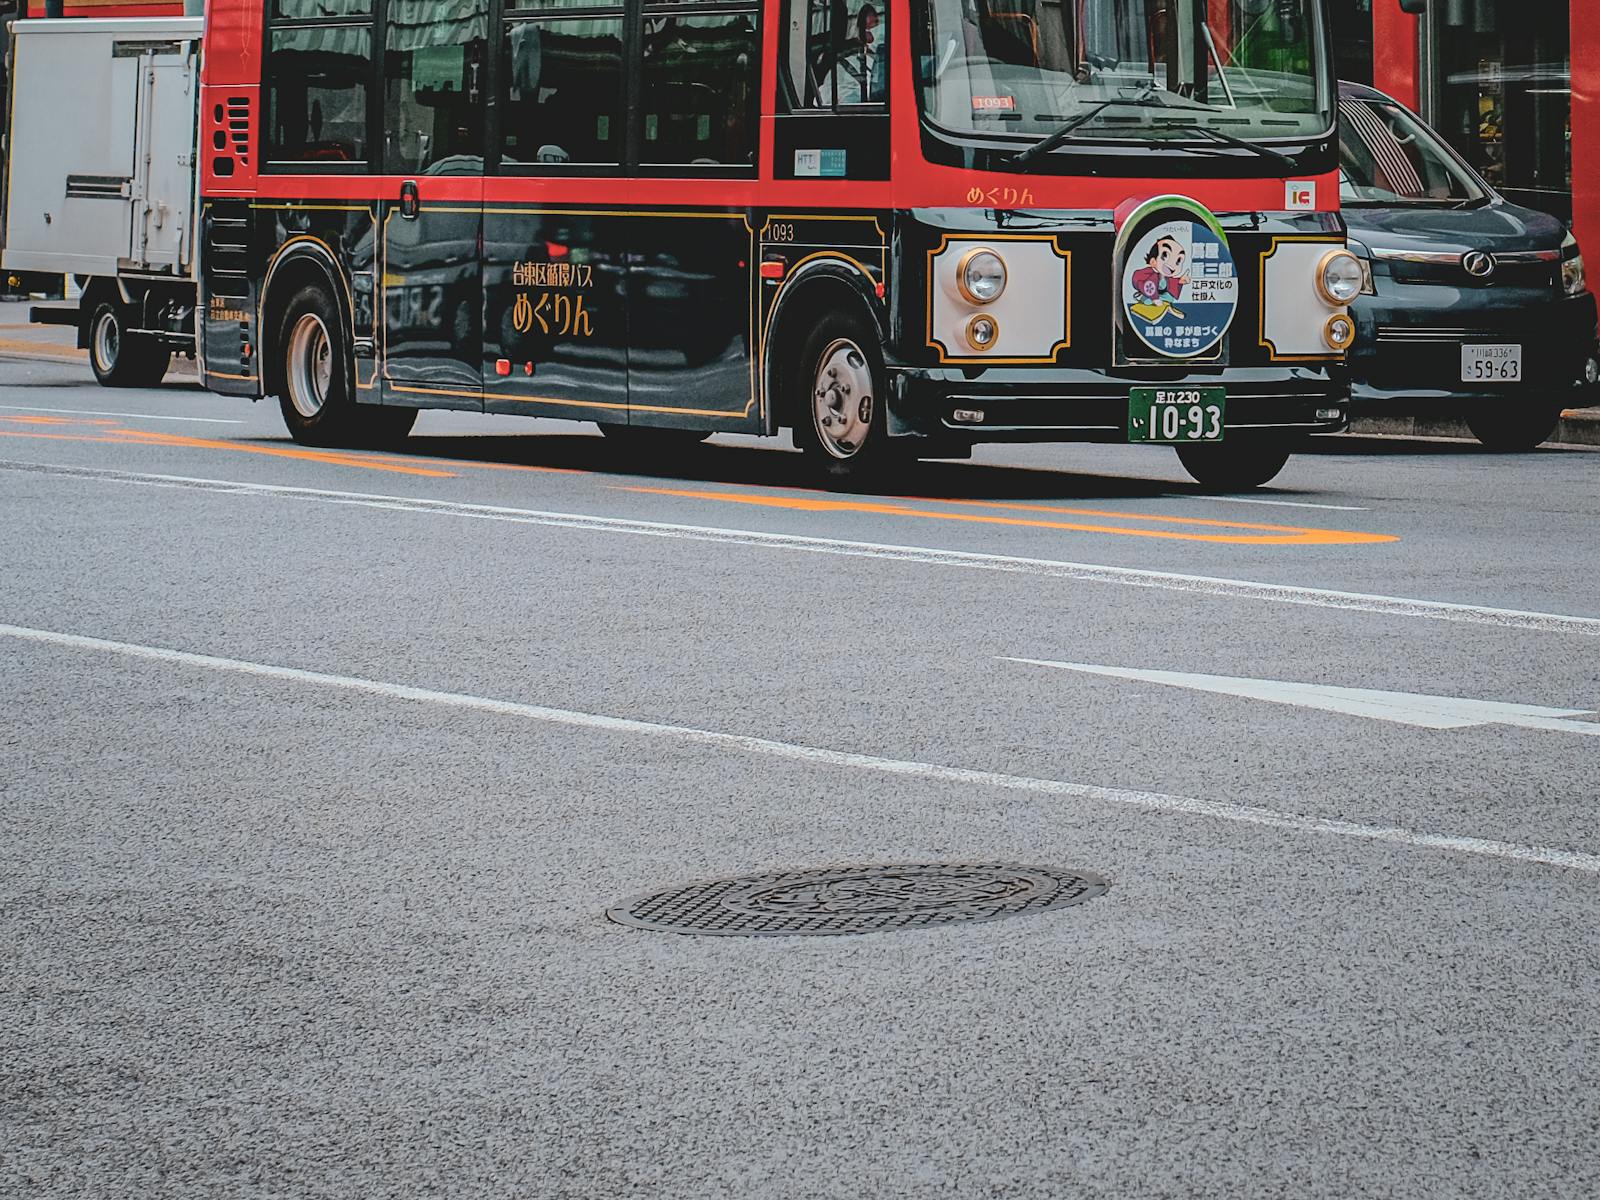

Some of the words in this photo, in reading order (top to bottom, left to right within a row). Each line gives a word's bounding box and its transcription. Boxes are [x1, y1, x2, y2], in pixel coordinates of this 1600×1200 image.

[977, 97, 1009, 108] 1093
[768, 223, 794, 241] 1093
[513, 261, 593, 287] 台東区循環バス
[513, 292, 594, 336] めぐりん
[1475, 360, 1518, 378] 59-63
[1149, 405, 1220, 439] 10-93
